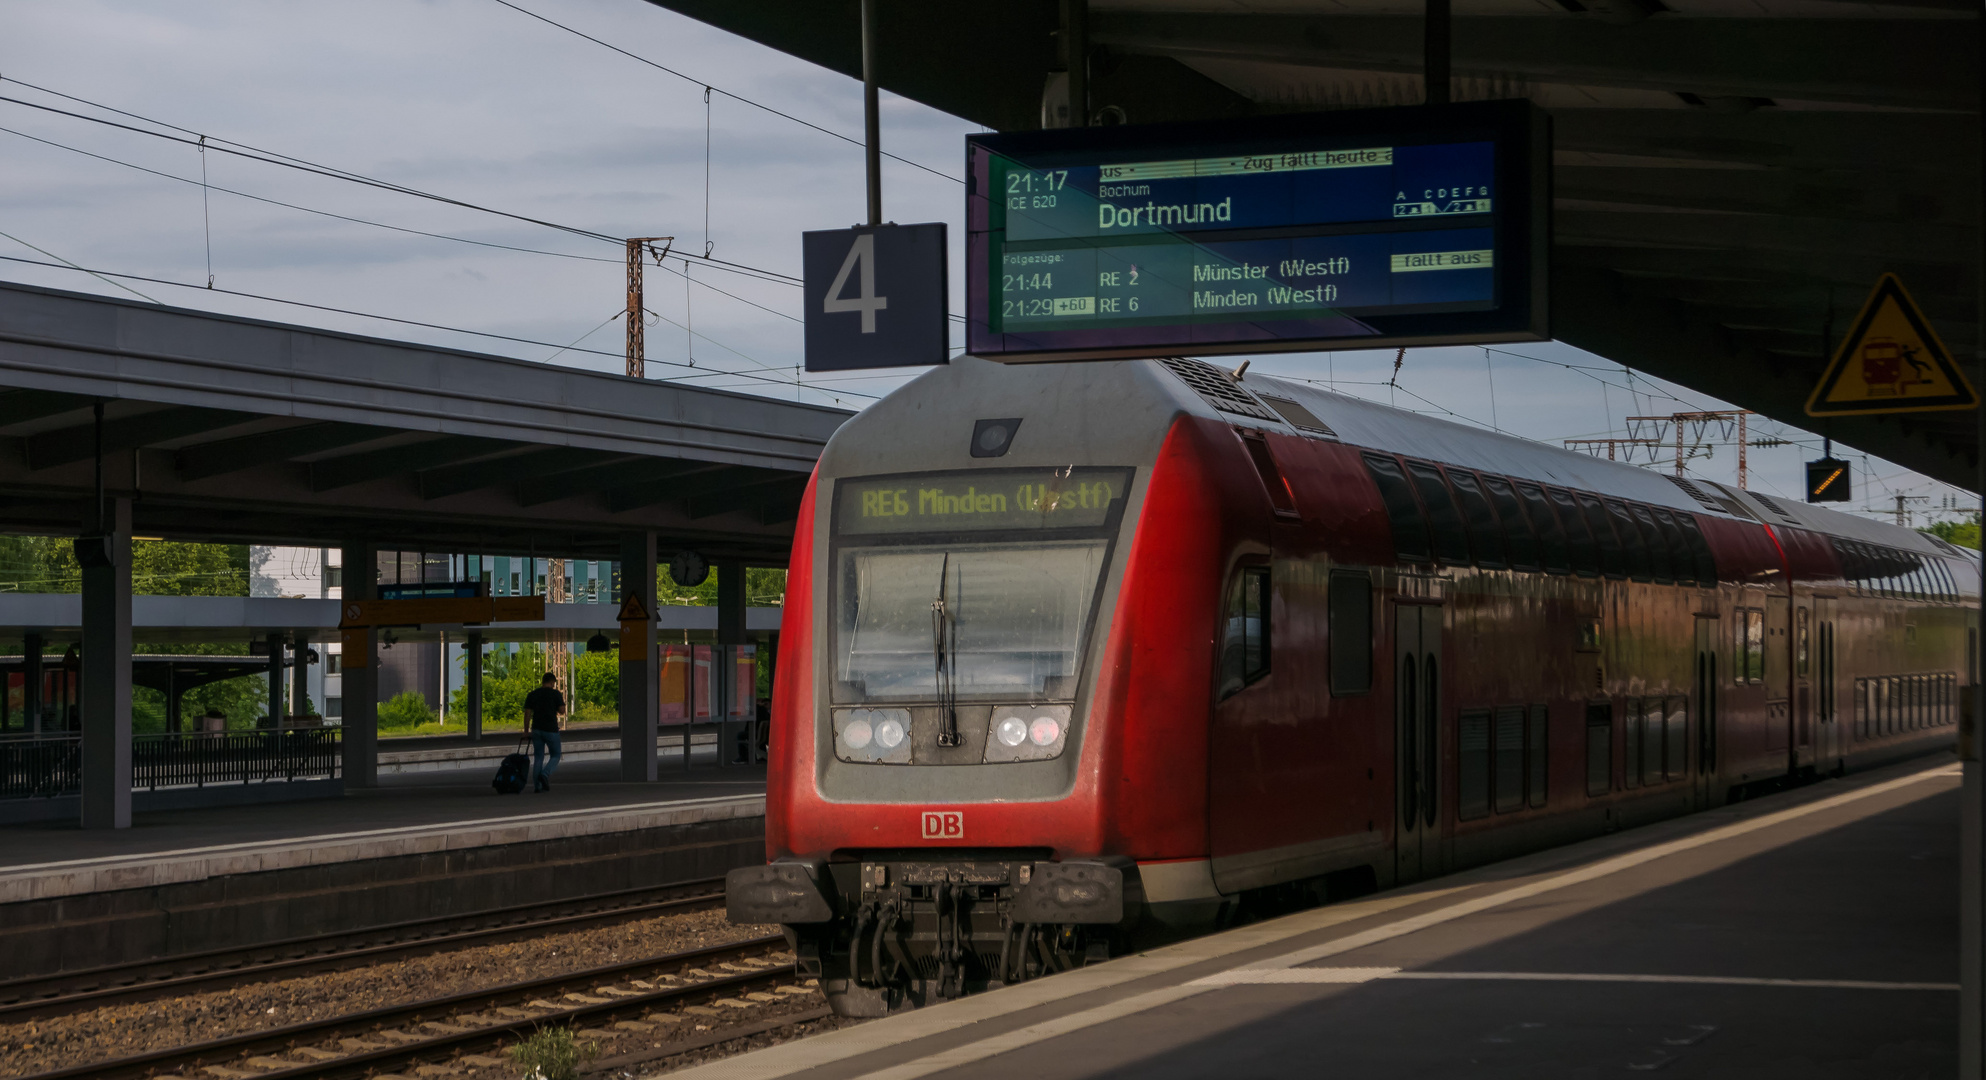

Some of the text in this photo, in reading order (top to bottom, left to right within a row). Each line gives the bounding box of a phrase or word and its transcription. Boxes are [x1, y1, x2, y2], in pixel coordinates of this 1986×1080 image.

[1243, 156, 1273, 171] Zug
[1326, 150, 1377, 165] heute
[1007, 170, 1069, 194] 21:17
[1100, 184, 1150, 198] Bochum
[1007, 195, 1057, 210] ICE 620
[1396, 190, 1407, 201] A
[1100, 197, 1231, 228] Dortmund
[1003, 253, 1064, 266] Folgezüge:
[824, 233, 887, 333] 4
[1003, 272, 1053, 292] 21:44
[1100, 271, 1121, 287] RE
[1129, 271, 1139, 286] 2
[1193, 262, 1269, 282] Münster
[1280, 257, 1350, 277] (Westf)
[1451, 253, 1481, 265] aus
[1003, 284, 1338, 318] 21:29 +60 RE 6 Minden (Westf)
[862, 489, 910, 517] RE6
[918, 487, 1007, 515] Minden
[925, 814, 960, 836] DB
